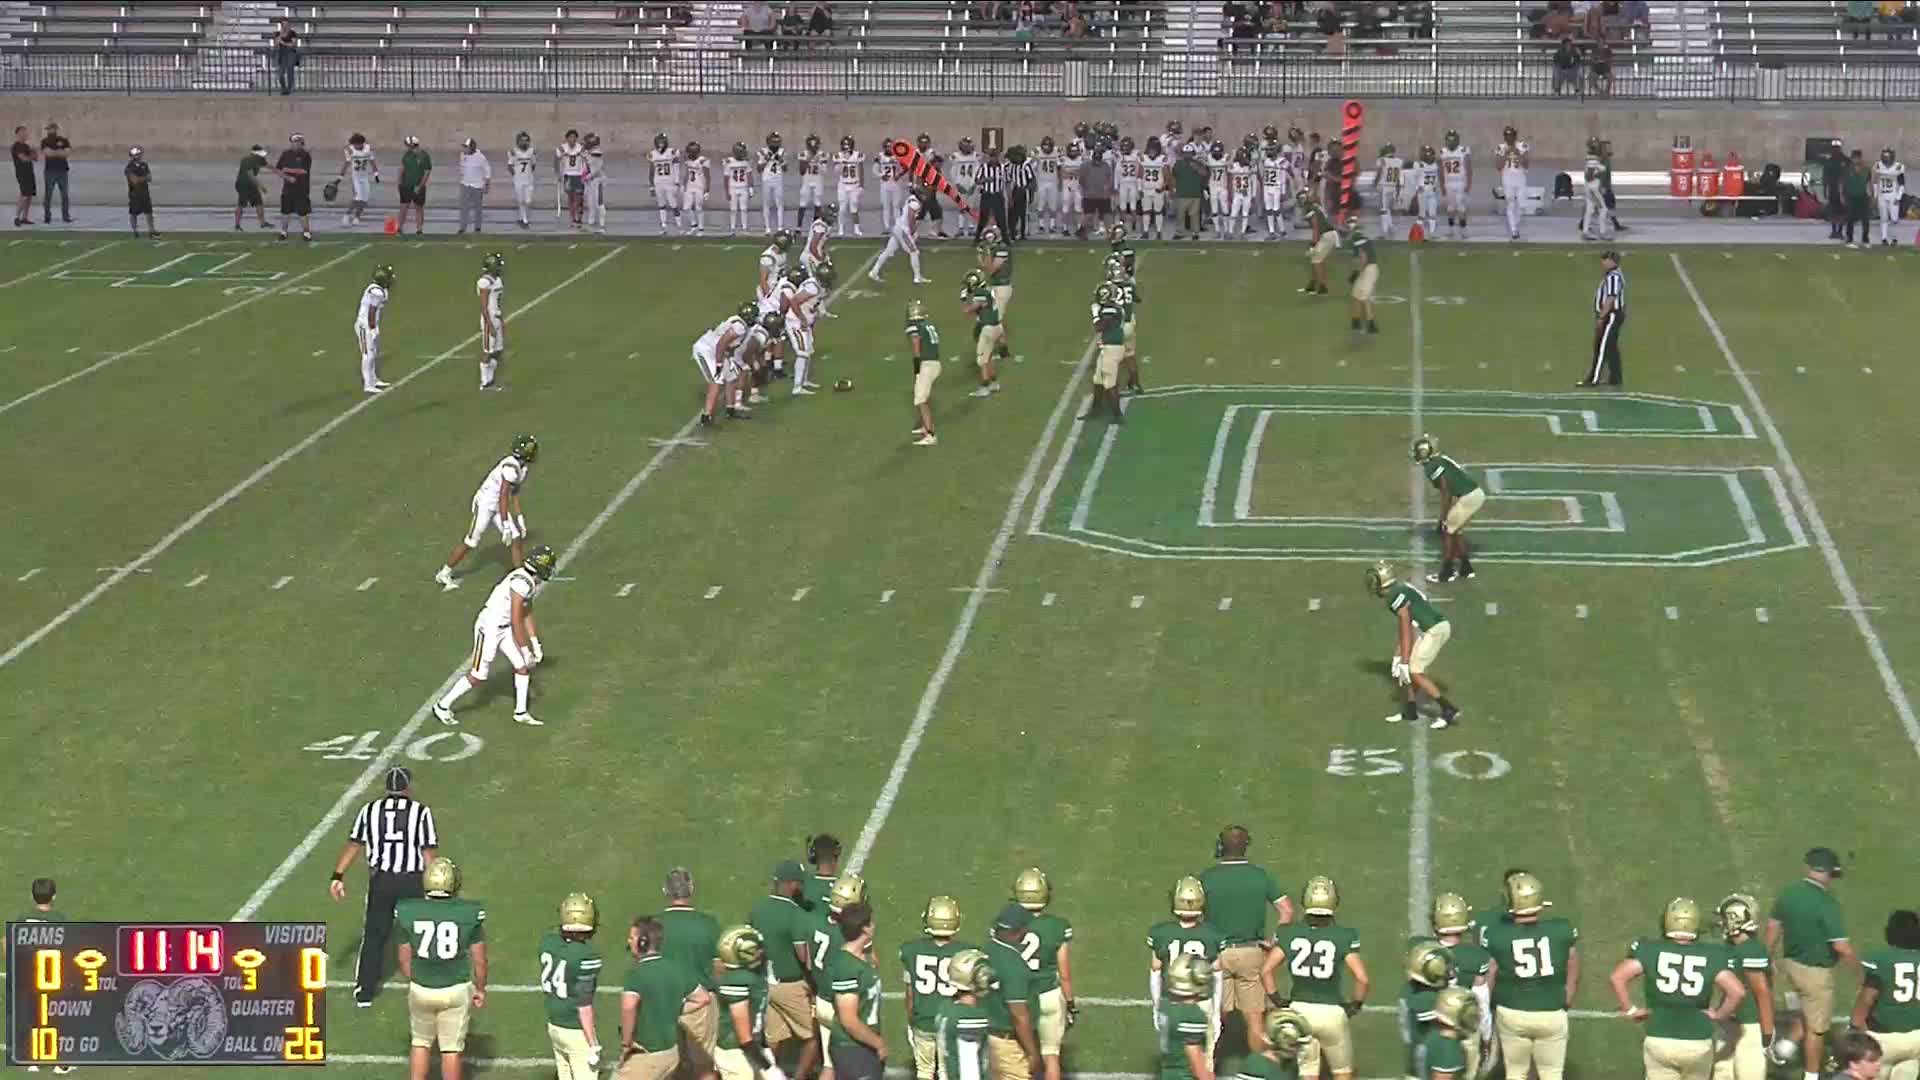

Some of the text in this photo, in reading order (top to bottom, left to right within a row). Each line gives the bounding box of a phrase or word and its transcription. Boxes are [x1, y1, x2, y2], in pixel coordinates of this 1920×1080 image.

[1115, 287, 1133, 305] 25
[384, 811, 403, 841] L
[413, 920, 459, 960] 78
[1290, 938, 1337, 979] 23
[1512, 935, 1555, 979] 51
[540, 952, 568, 999] 24
[1655, 951, 1707, 997] 55
[1893, 962, 1920, 1002] 5
